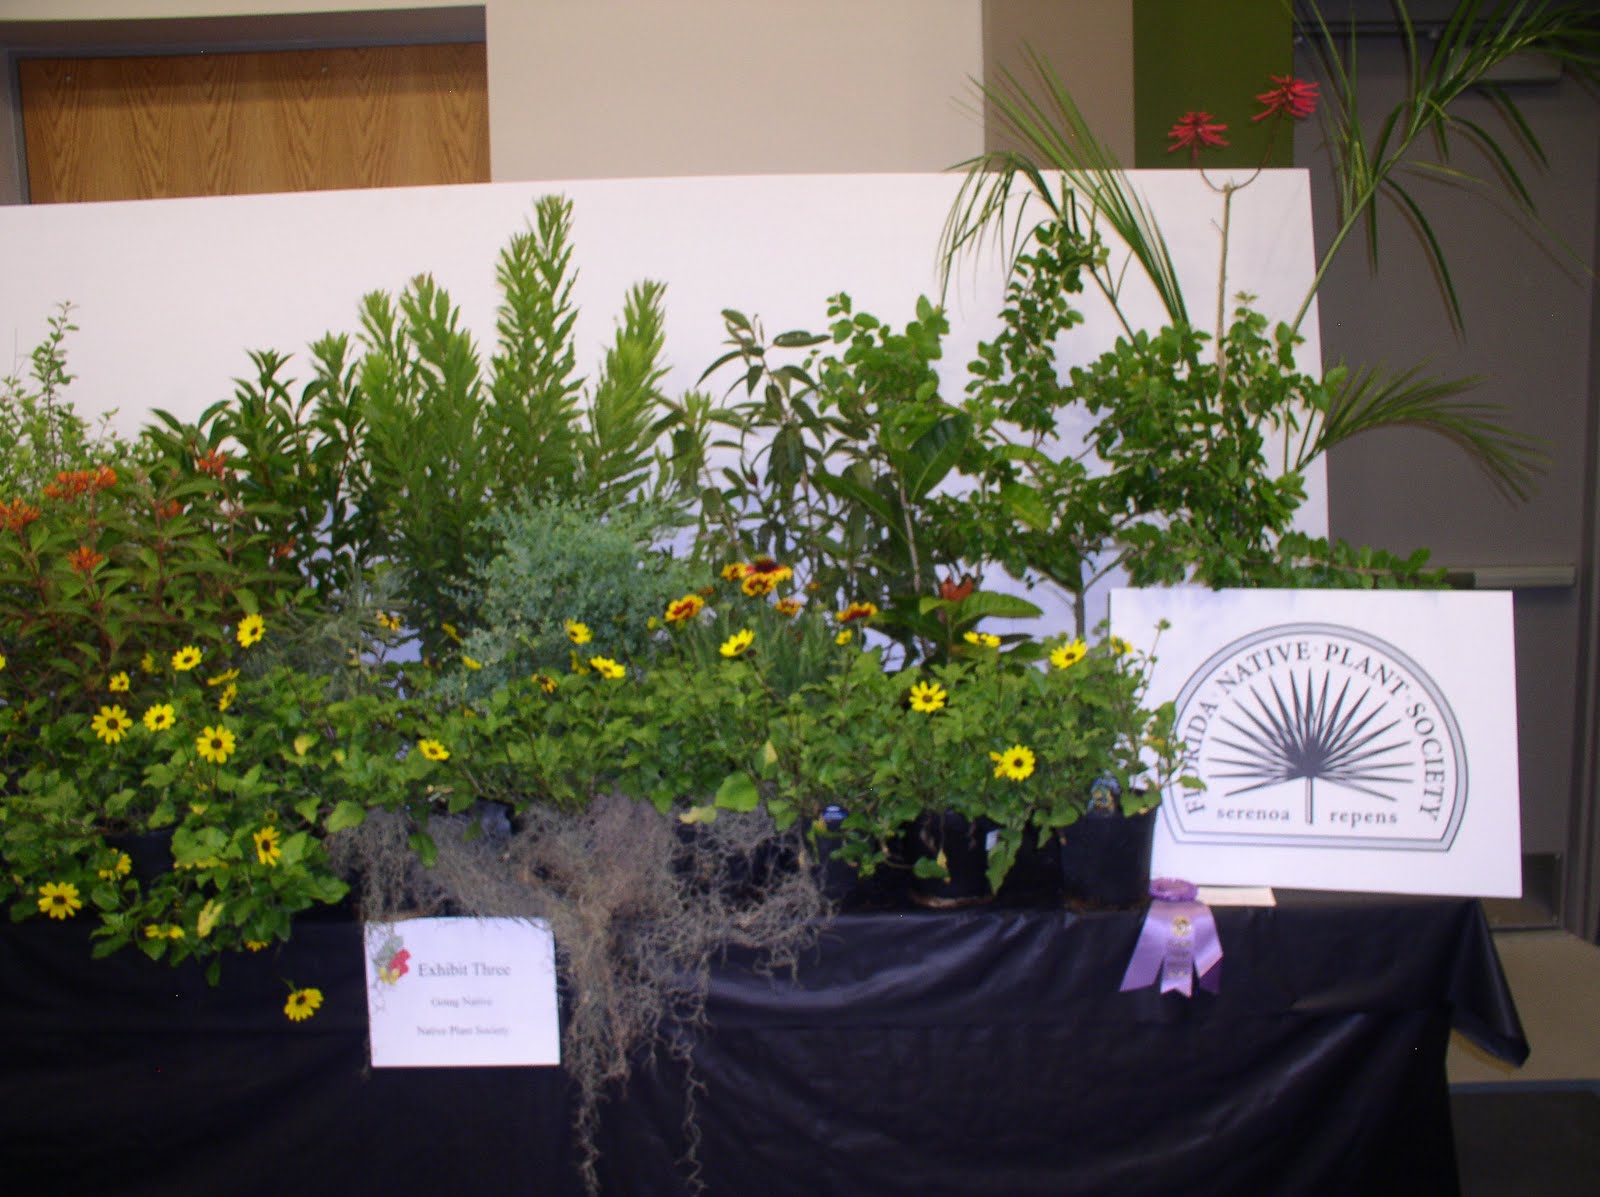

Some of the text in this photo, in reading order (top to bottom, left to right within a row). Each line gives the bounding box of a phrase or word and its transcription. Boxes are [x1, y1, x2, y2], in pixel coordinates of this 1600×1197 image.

[1216, 640, 1312, 697] NATIVE
[1324, 641, 1411, 698] PLANT
[1405, 701, 1447, 823] SOCIETY
[1216, 807, 1399, 828] serenoa repens
[418, 962, 512, 978] Exhibit Three
[416, 1025, 510, 1037] Native Plant Society
